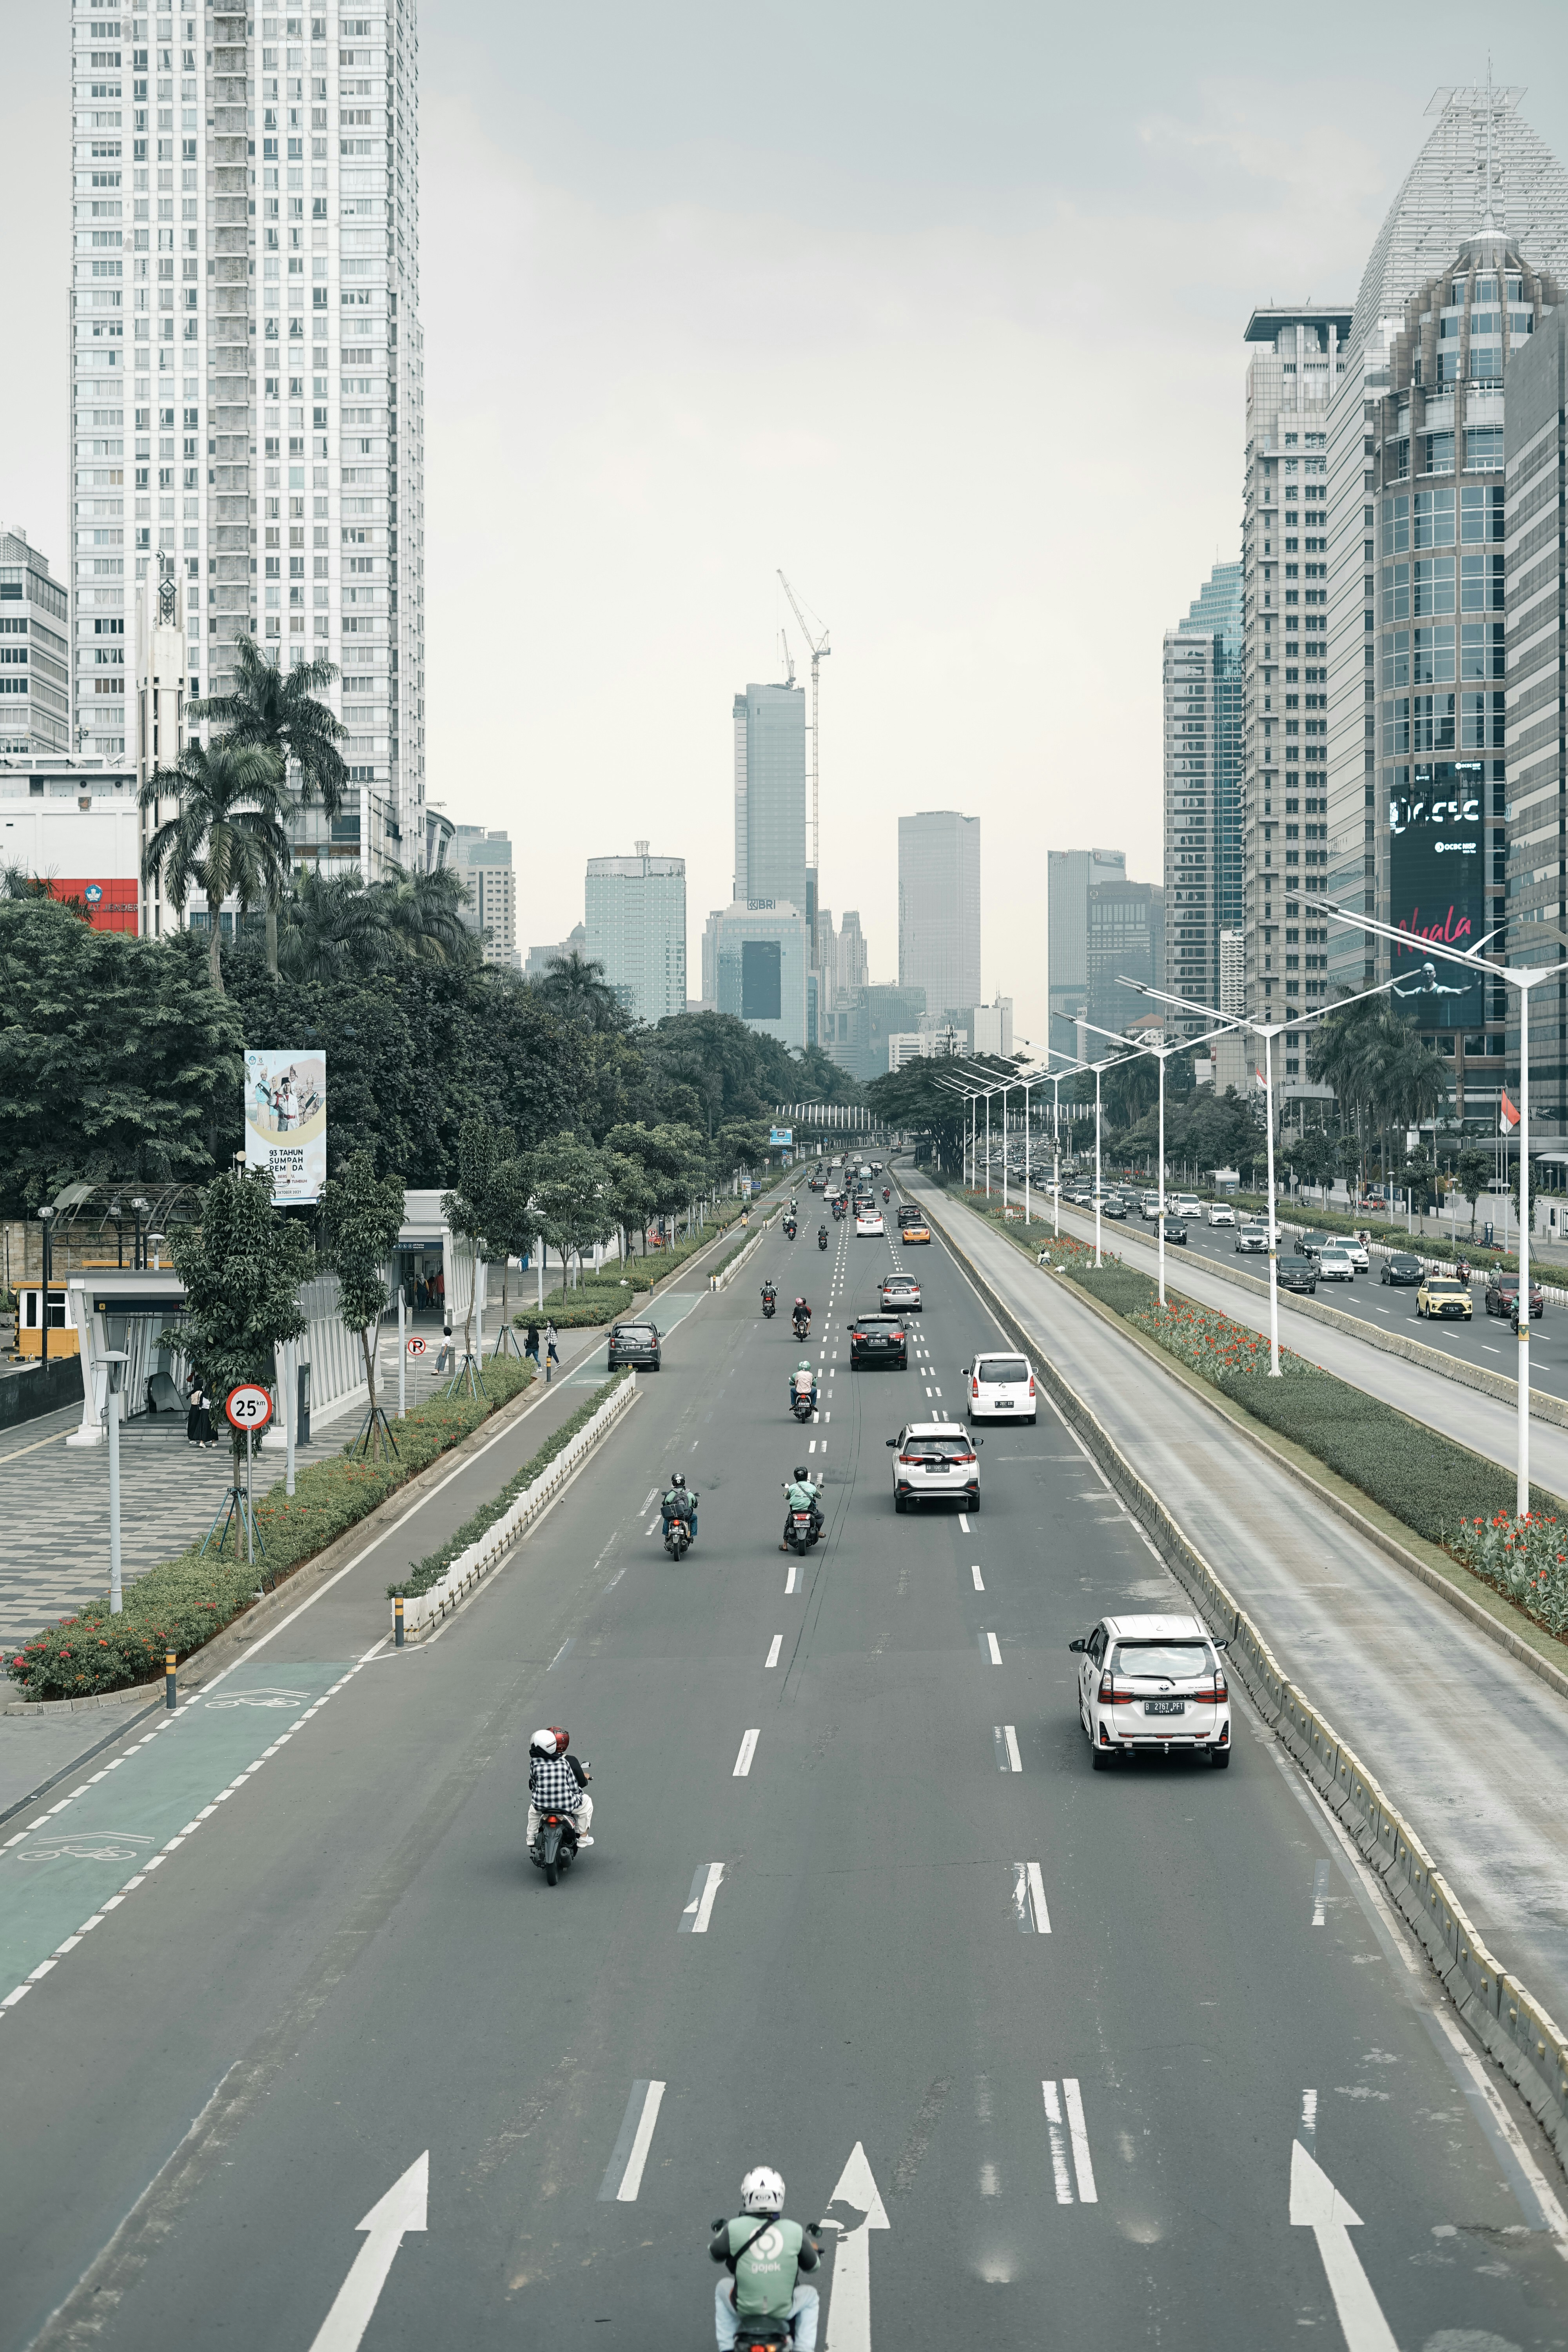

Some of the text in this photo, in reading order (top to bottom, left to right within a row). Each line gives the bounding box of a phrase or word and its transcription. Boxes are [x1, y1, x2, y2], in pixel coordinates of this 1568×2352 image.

[759, 900, 775, 909] BRI
[236, 1400, 256, 1416] 25
[751, 2261, 781, 2274] gojek
